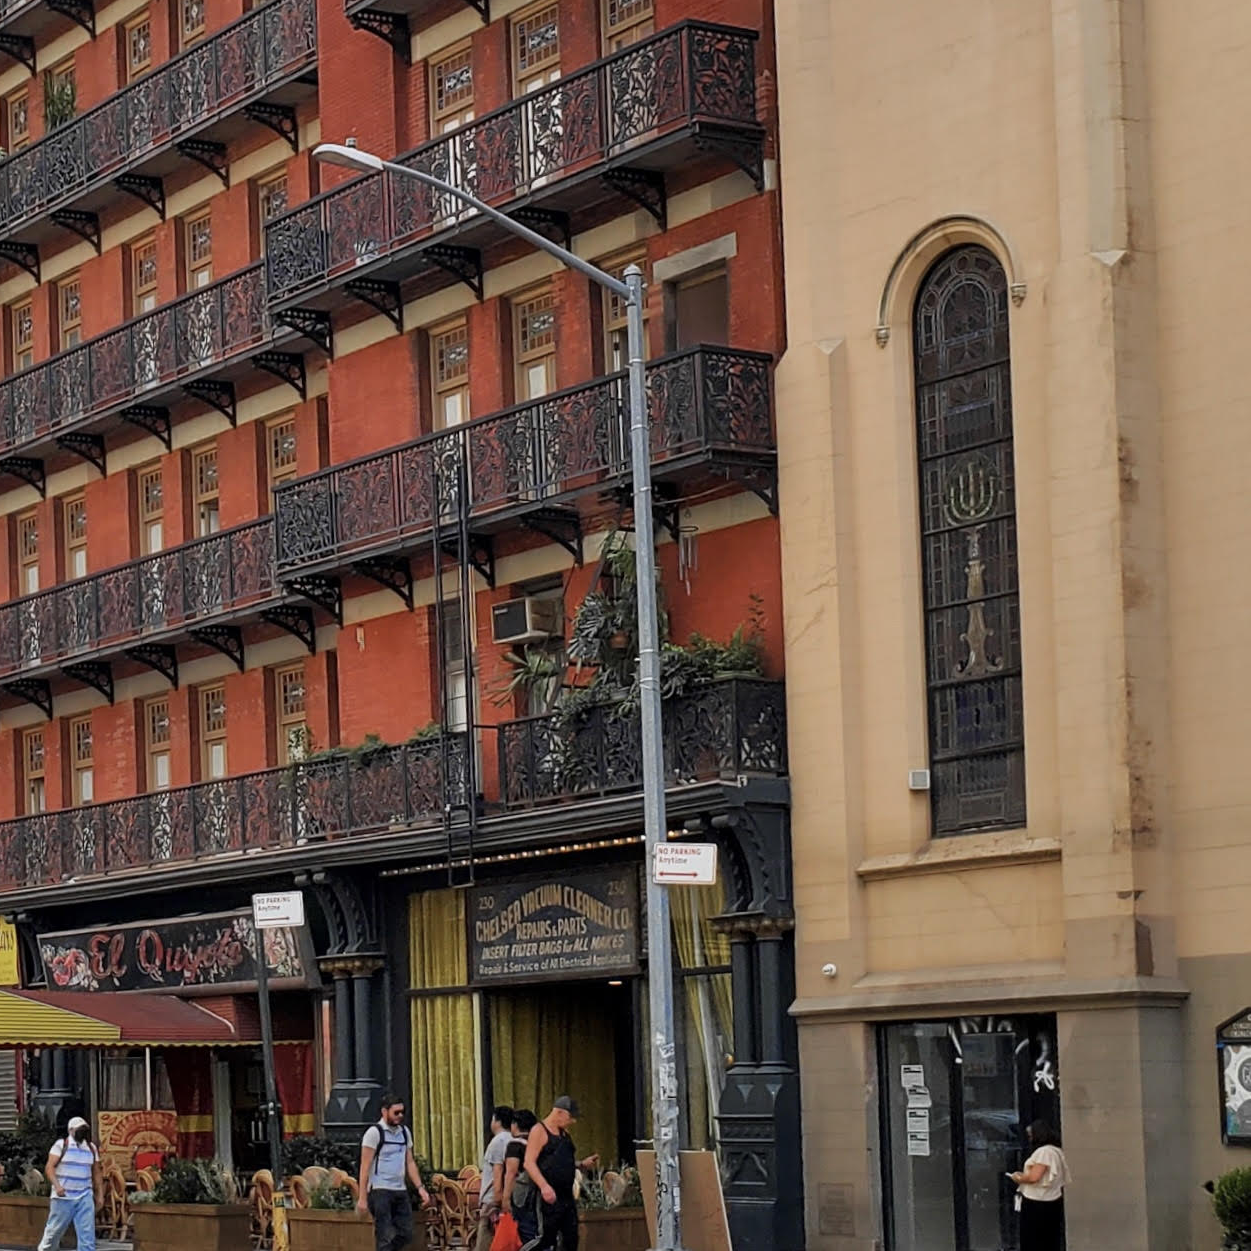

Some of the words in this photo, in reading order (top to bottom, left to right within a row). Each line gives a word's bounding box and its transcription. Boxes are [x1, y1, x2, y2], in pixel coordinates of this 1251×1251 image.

[607, 880, 627, 896] 230
[476, 900, 521, 942] CHELSEA
[521, 884, 562, 917] VACUUM
[563, 886, 613, 928] CLEANER
[479, 896, 495, 909] 230
[516, 920, 552, 941] REPAIRS
[558, 916, 588, 937] PARTS
[88, 932, 128, 980] El
[136, 929, 244, 984] Quijote
[482, 945, 510, 960] INSERT
[511, 943, 538, 957] FILTER
[539, 940, 563, 955] BAGS
[573, 937, 588, 951] ALL
[590, 934, 625, 950] MAKES
[479, 963, 502, 975] Repair
[509, 961, 539, 973] Service
